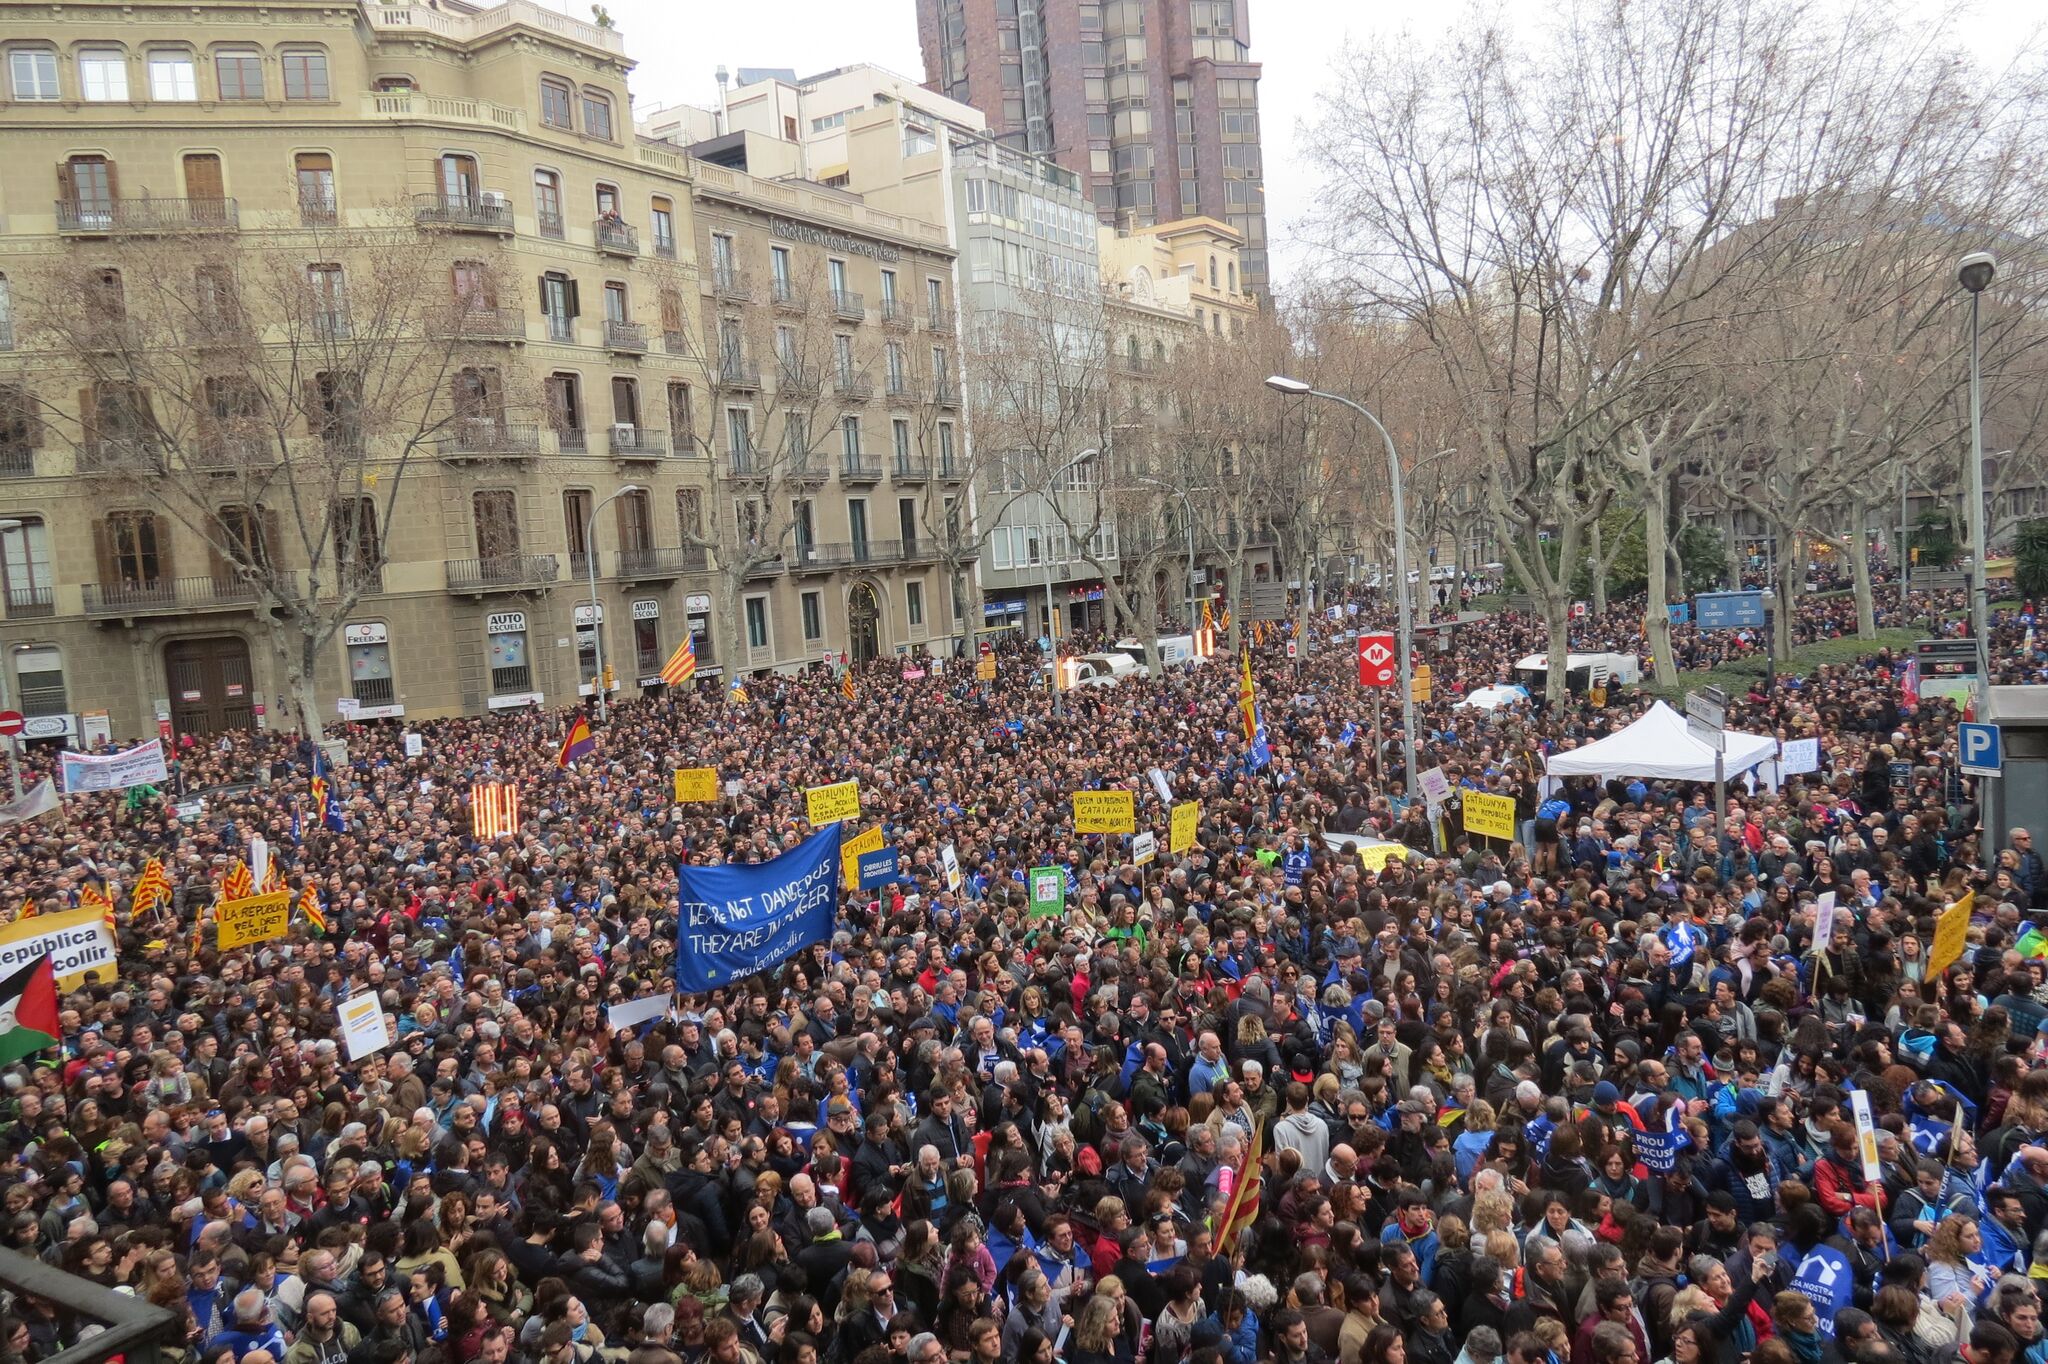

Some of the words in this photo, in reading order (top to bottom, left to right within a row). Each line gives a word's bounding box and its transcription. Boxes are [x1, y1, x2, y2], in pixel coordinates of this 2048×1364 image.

[635, 602, 657, 611] AUTO
[490, 613, 522, 625] AUTO
[634, 610, 657, 618] ESCOLA
[577, 617, 602, 625] FREEDM
[489, 623, 524, 632] ESCUELA
[348, 635, 385, 643] FREEDOM
[1370, 648, 1384, 660] M
[694, 668, 723, 679] nostrum
[640, 677, 666, 687] nostru
[1966, 728, 1991, 762] P
[810, 785, 856, 802] CATALUNYA
[813, 802, 829, 811] VOL
[1466, 794, 1507, 810] CATALUNYA
[1081, 806, 1124, 815] CATALANA
[863, 860, 882, 872] OBRIU
[223, 909, 238, 921] LA
[234, 920, 254, 931] PEL
[260, 916, 282, 926] DRET
[689, 934, 731, 954] THEY
[730, 927, 764, 952] ARE
[53, 946, 108, 972] collir
[1635, 1133, 1665, 1147] PROU
[1789, 1279, 1802, 1287] ASA
[1802, 1282, 1834, 1298] NOSTRA
